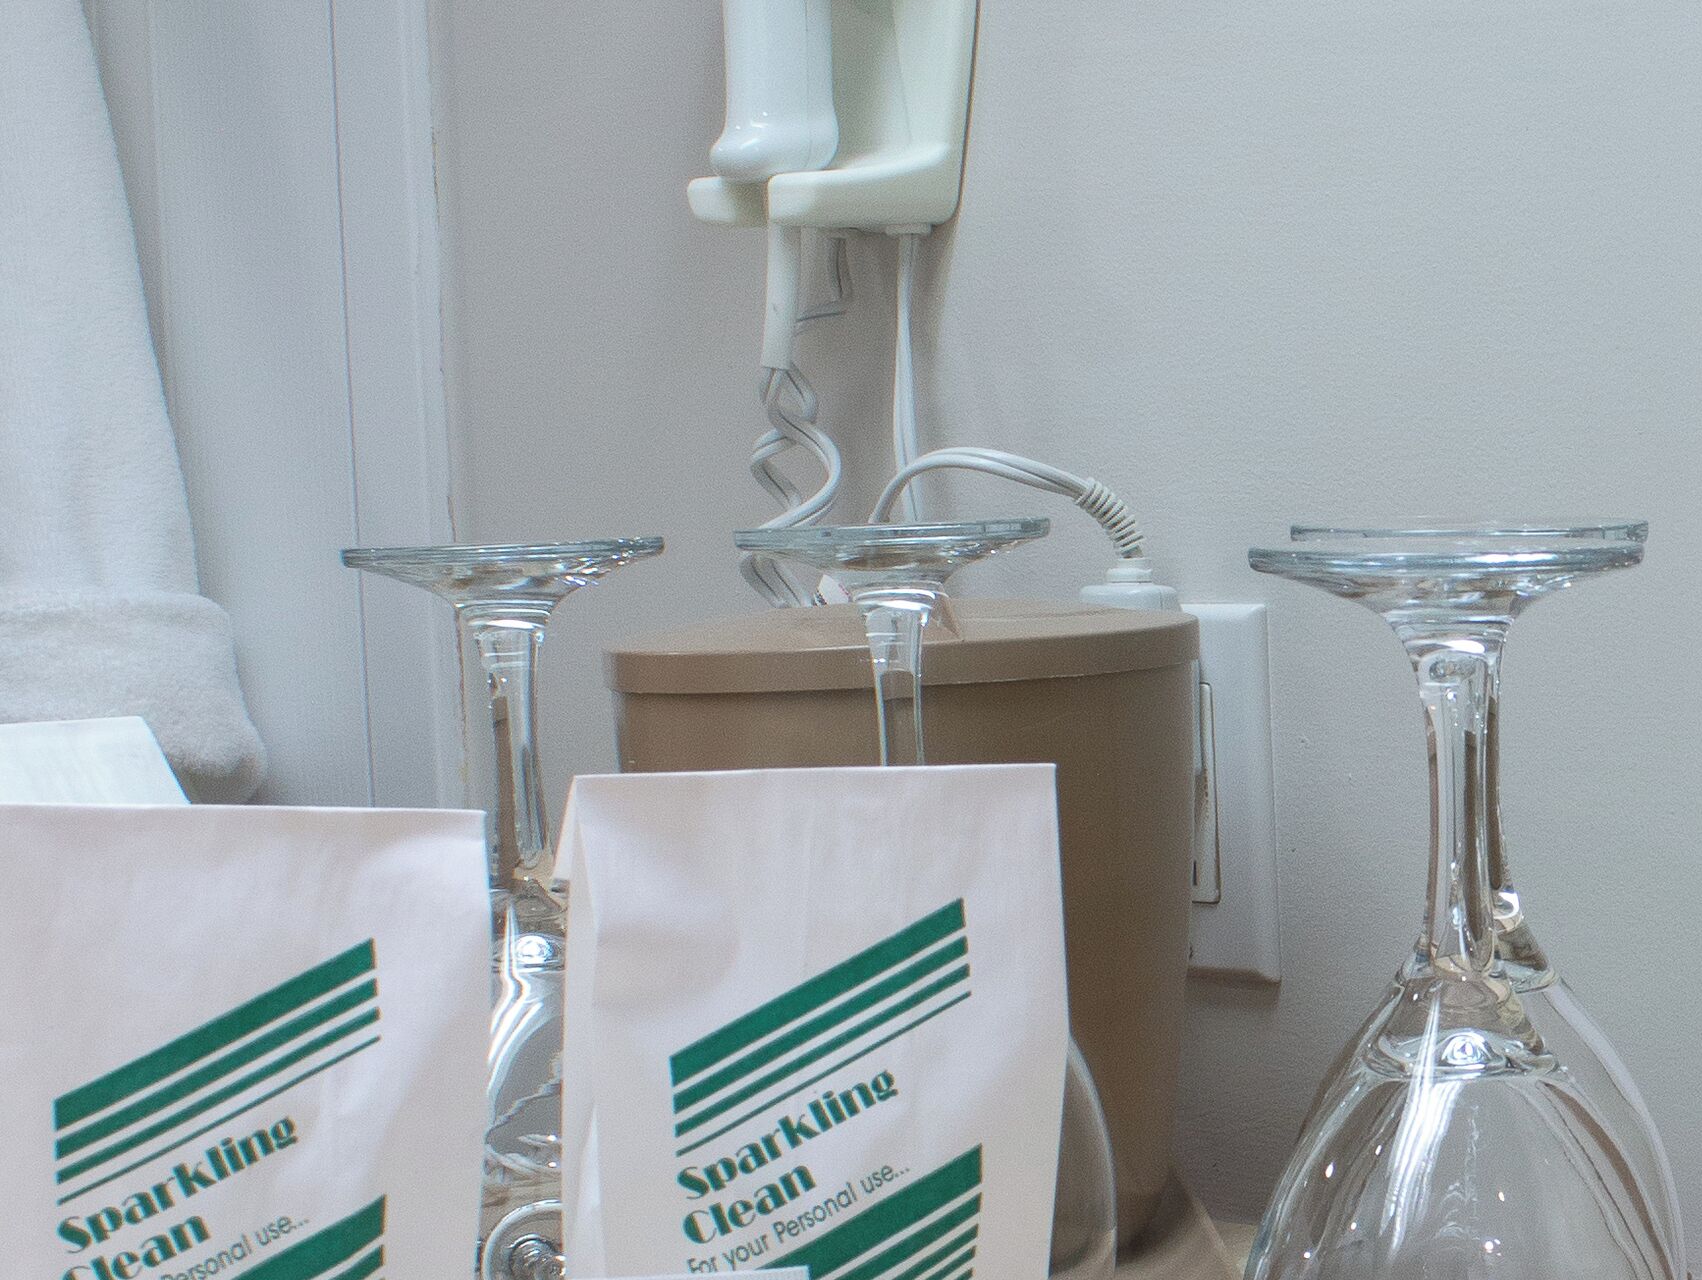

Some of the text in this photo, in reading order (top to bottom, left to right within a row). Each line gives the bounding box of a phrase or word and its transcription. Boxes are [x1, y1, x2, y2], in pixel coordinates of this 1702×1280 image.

[56, 1115, 298, 1254] Sparkling
[676, 1070, 898, 1199] Sparkling
[682, 1165, 816, 1244] Clean
[687, 1165, 910, 1272] For your Personal use...
